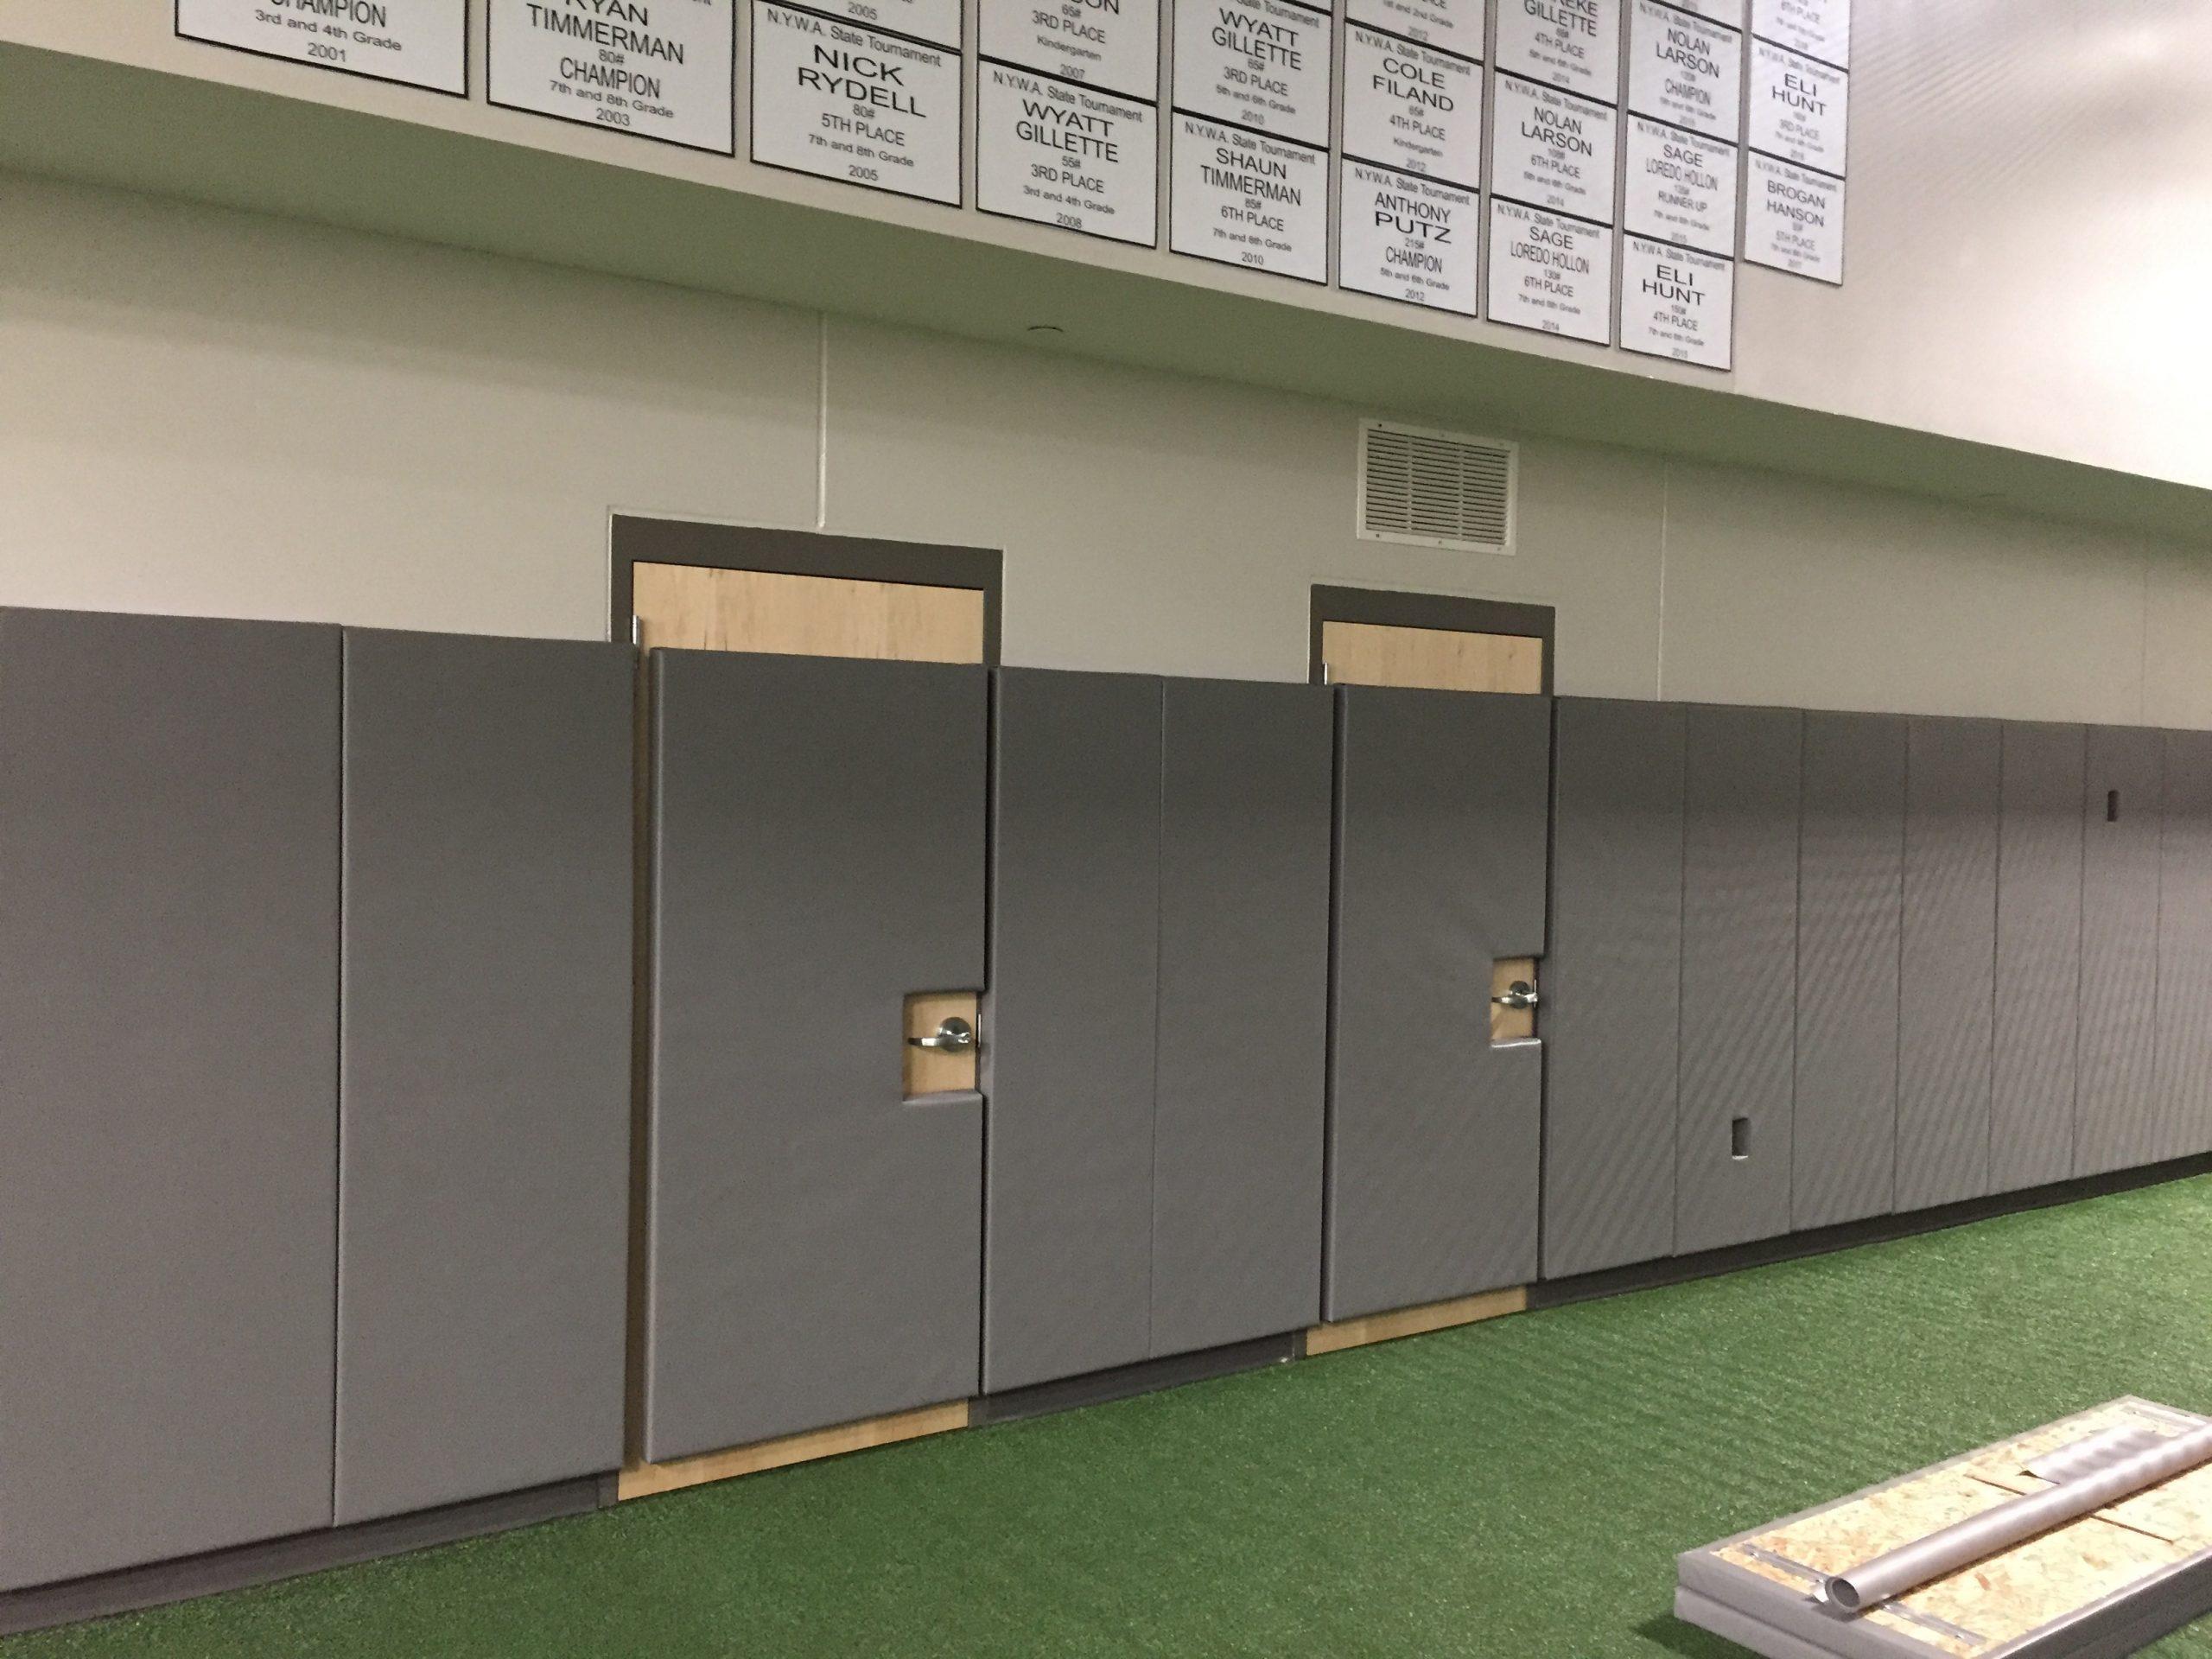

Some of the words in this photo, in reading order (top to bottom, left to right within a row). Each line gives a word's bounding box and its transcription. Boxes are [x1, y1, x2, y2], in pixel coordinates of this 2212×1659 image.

[848, 1, 877, 21] 2005
[1263, 0, 1319, 28] Tournament
[1524, 0, 1596, 37] GILLETTE
[255, 9, 282, 25] 3rd
[287, 18, 317, 33] and
[322, 24, 347, 39] 4th
[353, 31, 402, 51] Grade
[526, 3, 683, 65] TIMMERMAN
[1032, 10, 1058, 29] 3RD
[1063, 19, 1105, 44] PLACE
[1219, 7, 1299, 47] WYATT
[308, 42, 346, 62] 2001
[830, 25, 863, 47] State
[867, 35, 942, 67] Tournament
[1037, 35, 1101, 60] Kindergarten
[1211, 26, 1301, 71] GILLETTE
[1396, 43, 1419, 60] State
[1554, 38, 1584, 59] PLACE
[1668, 28, 1710, 55] NOLAN
[599, 48, 624, 66] 80#
[814, 44, 904, 86] NICK
[1059, 63, 1085, 79] 2007
[1656, 41, 1719, 78] LARSON
[560, 57, 660, 99] CHAMPION
[1224, 66, 1248, 84] 3RD
[1250, 73, 1287, 97] PLACE
[1382, 57, 1445, 89] COLE
[1784, 73, 1816, 97] ELI
[550, 79, 571, 94] 7th
[575, 89, 602, 102] and
[606, 93, 627, 107] 8th
[632, 99, 674, 118] Grade
[798, 67, 926, 118] RYDELL
[1047, 85, 1076, 105] State
[1078, 93, 1142, 123] Tournament
[1232, 92, 1249, 101] and
[1268, 99, 1296, 114] Grade
[1373, 74, 1453, 111] FILAND
[1665, 78, 1711, 105] CHAMPION
[1772, 86, 1826, 116] HUNT
[596, 107, 630, 126] 2003
[853, 104, 874, 118] 80#
[1022, 99, 1114, 137] WYATT
[1534, 106, 1581, 135] NOLAN
[822, 112, 851, 132] 5TH
[855, 121, 905, 147] PLACE
[1016, 120, 1118, 162] GILLETTE
[1389, 114, 1409, 130] 4TH
[1412, 120, 1445, 141] PLACE
[1522, 121, 1592, 156] LARSON
[809, 133, 828, 146] 7th
[830, 141, 854, 153] and
[855, 145, 874, 157] 8th
[878, 150, 914, 167] Grade
[1232, 133, 1256, 150] State
[1260, 140, 1315, 164] Tournament
[1663, 143, 1702, 168] SAGE
[849, 164, 878, 181] 2005
[1216, 147, 1286, 180] SHAUN
[1646, 158, 1681, 181] LOREDO
[1684, 169, 1717, 191] HOLLON
[1031, 163, 1058, 181] 3RD
[1062, 171, 1104, 194] PLACE
[1200, 164, 1300, 206] TIMMERMAN
[1396, 177, 1418, 193] State
[1421, 183, 1469, 205] Tournament
[1023, 185, 1040, 197] 3rd
[1042, 192, 1063, 202] and
[1065, 195, 1081, 207] 4th
[1084, 200, 1115, 214] Grade
[1375, 192, 1451, 223] ANTHONY
[1658, 190, 1694, 209] RUNNER
[1695, 201, 1707, 212] UP
[1767, 180, 1825, 209] BROGAN
[1221, 206, 1243, 221] 6TH
[1246, 211, 1284, 232] PLACE
[1534, 213, 1554, 226] State
[1766, 199, 1824, 227] HANSON
[1213, 227, 1227, 238] 7th
[1229, 232, 1246, 242] and
[1264, 238, 1292, 251] Grade
[1375, 211, 1451, 244] PUTZ
[1529, 226, 1573, 250] SAGE
[1242, 251, 1264, 265] 2010
[1386, 245, 1442, 273] CHAMPION
[1510, 242, 1550, 264] LOREDO
[1552, 251, 1589, 274] HOLLON
[1380, 267, 1393, 276] 5th
[1395, 272, 1409, 281] and
[1411, 274, 1424, 284] 6th
[1426, 278, 1449, 290] Grade
[1524, 276, 1541, 289] 6TH
[1544, 280, 1573, 297] PLACE
[1656, 264, 1693, 286] ELI
[1405, 289, 1424, 302] 2012
[1518, 293, 1529, 302] 7th
[1531, 298, 1545, 307] and
[1559, 302, 1580, 315] Grade
[1643, 278, 1705, 306] HUNT
[1671, 315, 1697, 331] PLACE
